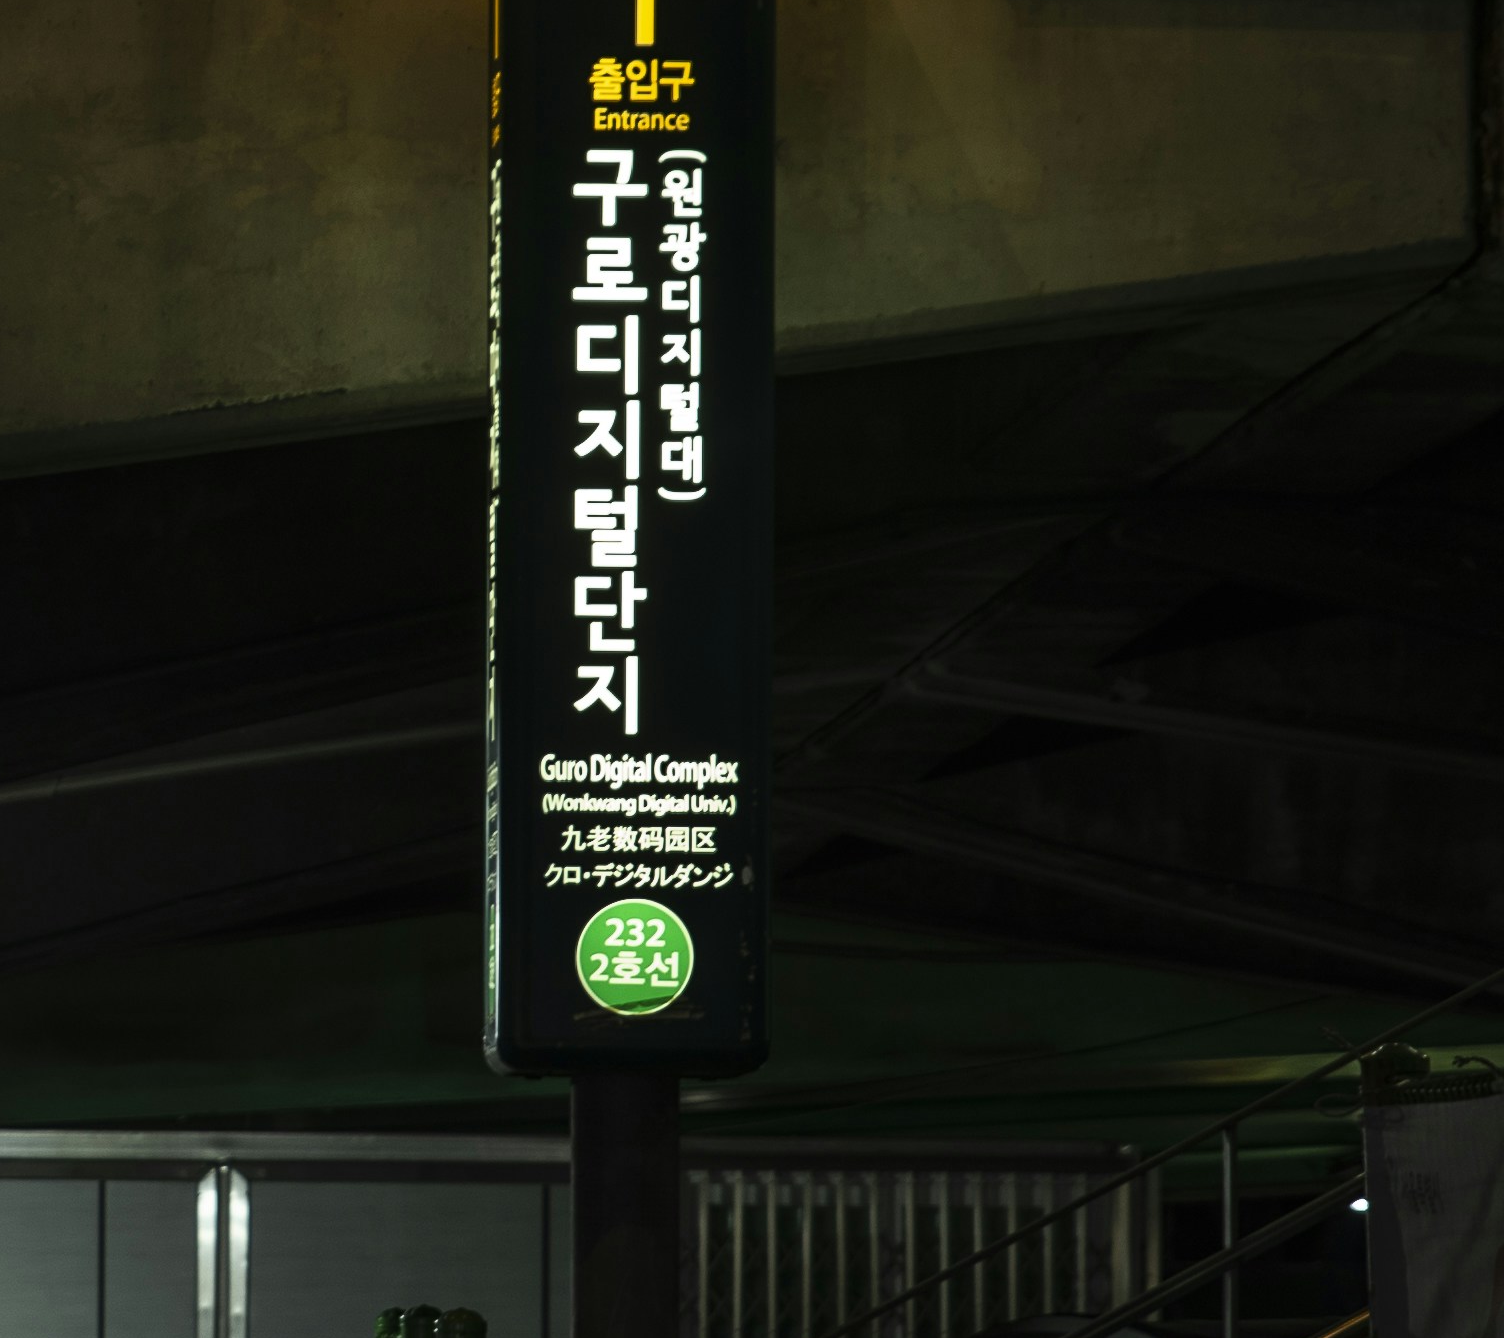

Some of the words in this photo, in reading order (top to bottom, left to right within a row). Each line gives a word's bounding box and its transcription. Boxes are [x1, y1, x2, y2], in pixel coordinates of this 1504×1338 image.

[589, 57, 695, 102] 출입구
[593, 106, 691, 132] Entrance
[657, 148, 708, 503] (원광디지털대)
[571, 148, 650, 736] 구로디지털단지
[540, 753, 588, 783] Guro
[590, 752, 652, 789] Digital
[653, 753, 739, 790] Complex
[541, 793, 637, 817] (Wonkwang
[637, 793, 690, 816] Digital
[690, 793, 738, 816] Univ.)
[560, 824, 718, 854] 九老数码园区
[604, 917, 667, 948] 232
[588, 950, 681, 988] 2호선
